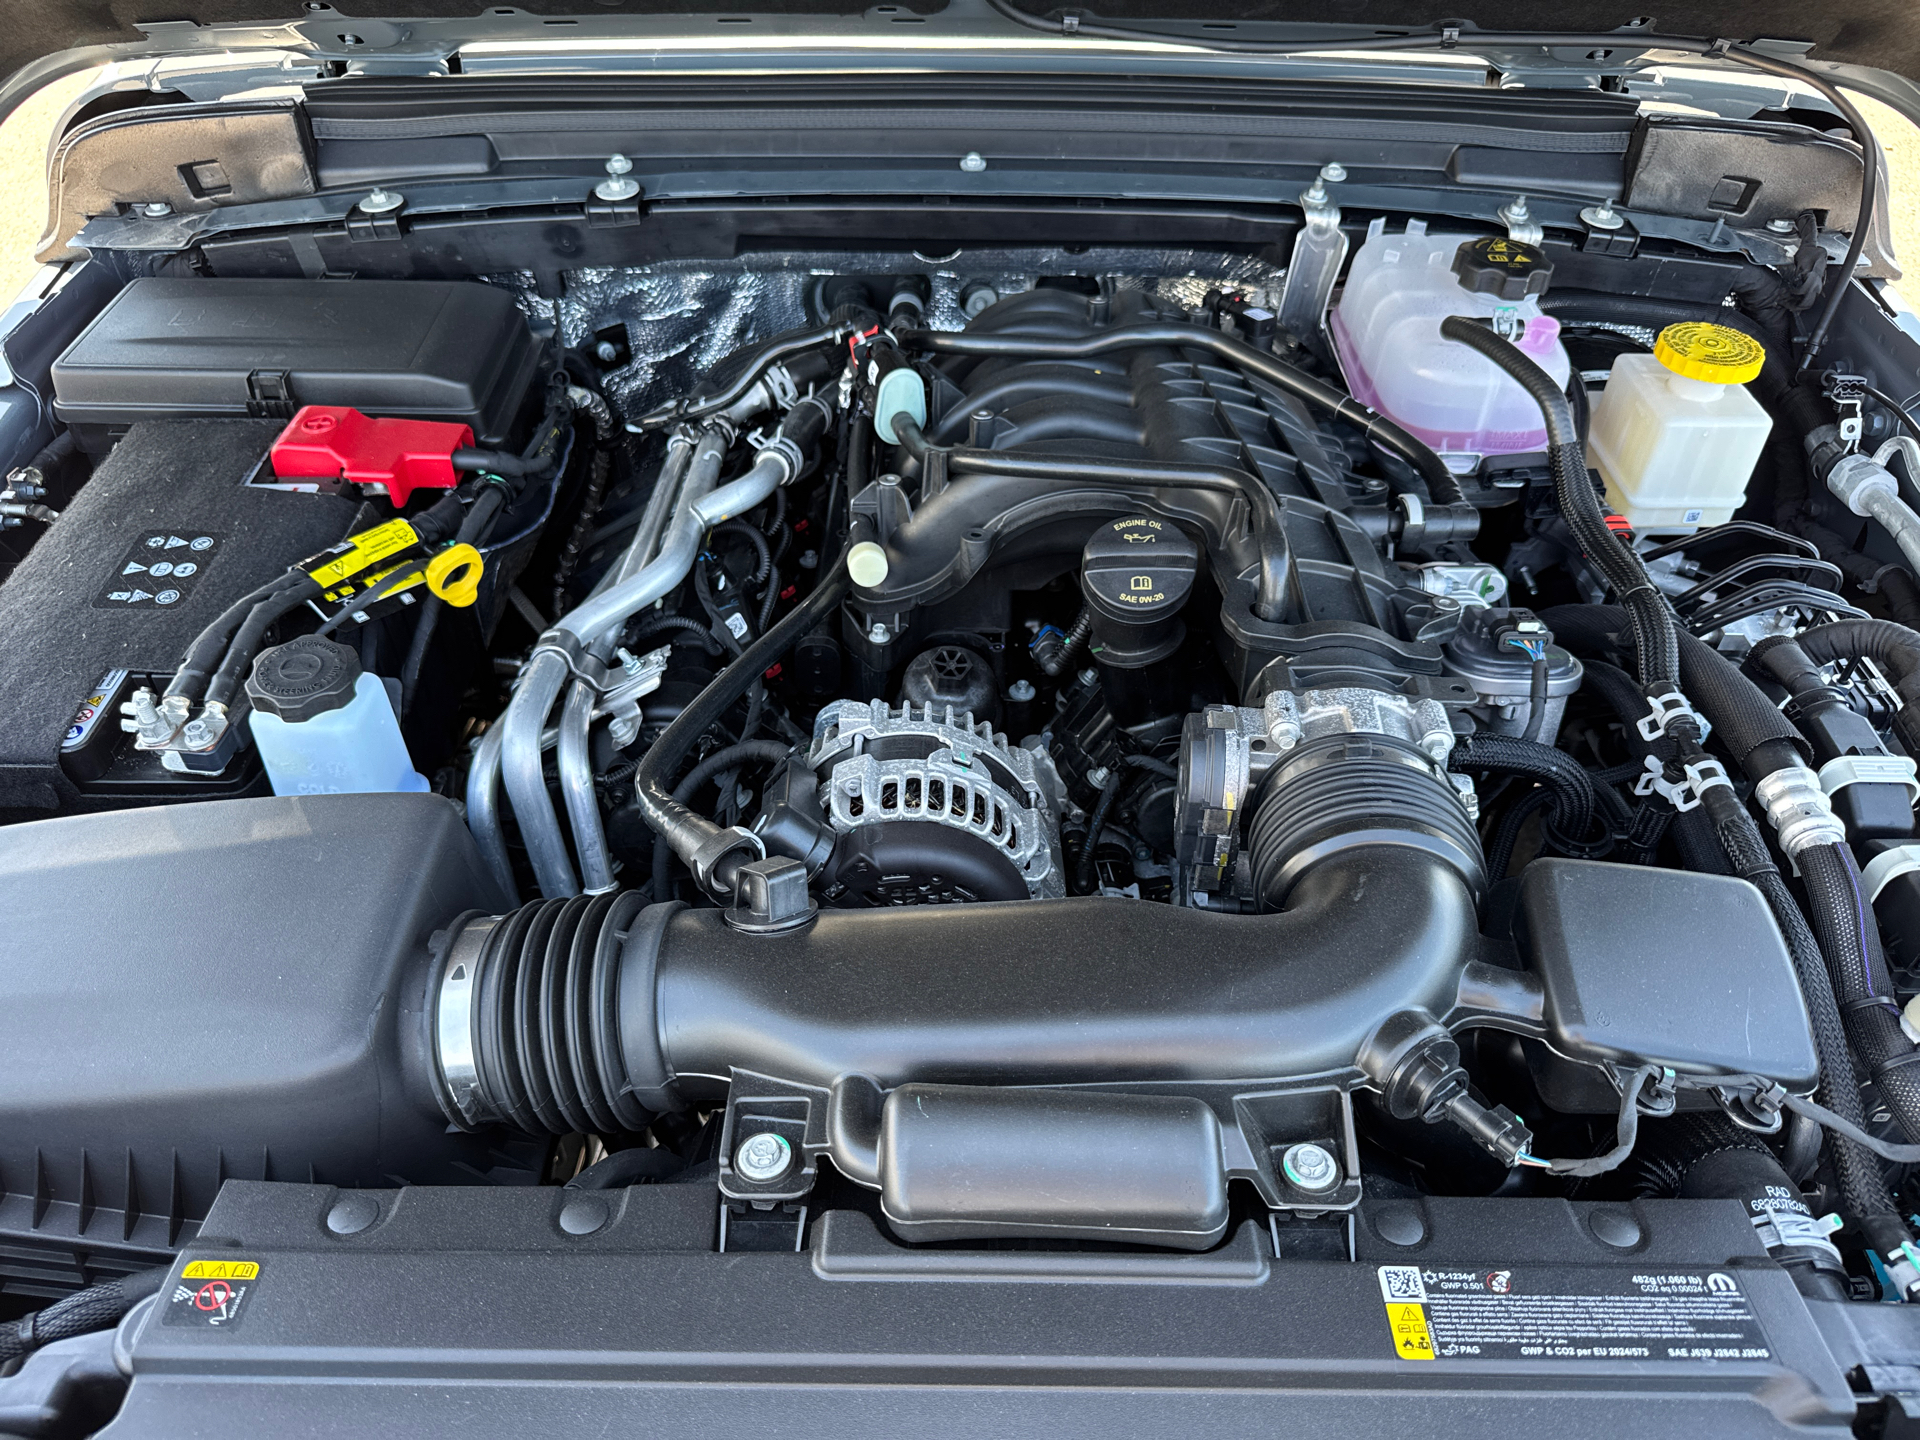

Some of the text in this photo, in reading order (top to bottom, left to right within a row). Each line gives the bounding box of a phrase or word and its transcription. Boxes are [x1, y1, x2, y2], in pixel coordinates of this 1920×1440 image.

[1113, 519, 1162, 531] ENGINE OIL
[1119, 593, 1164, 603] SAE 0W-20
[292, 641, 339, 654] APPROVED
[273, 682, 321, 695] STEERING
[320, 665, 341, 685] FLUID
[1764, 1185, 1791, 1198] RAD
[1438, 1272, 1476, 1282] R-1234yf
[1632, 1275, 1703, 1285] 482g (1.060 lb)
[1440, 1282, 1484, 1290] GWP 0.501
[1660, 1286, 1671, 1294] eq
[1672, 1285, 1702, 1293] 0.00024
[1459, 1346, 1481, 1355] PAG
[1520, 1346, 1650, 1357] GWP & CO2 per EU 2024/573
[1667, 1347, 1689, 1357] SAE
[1690, 1348, 1712, 1358] J639
